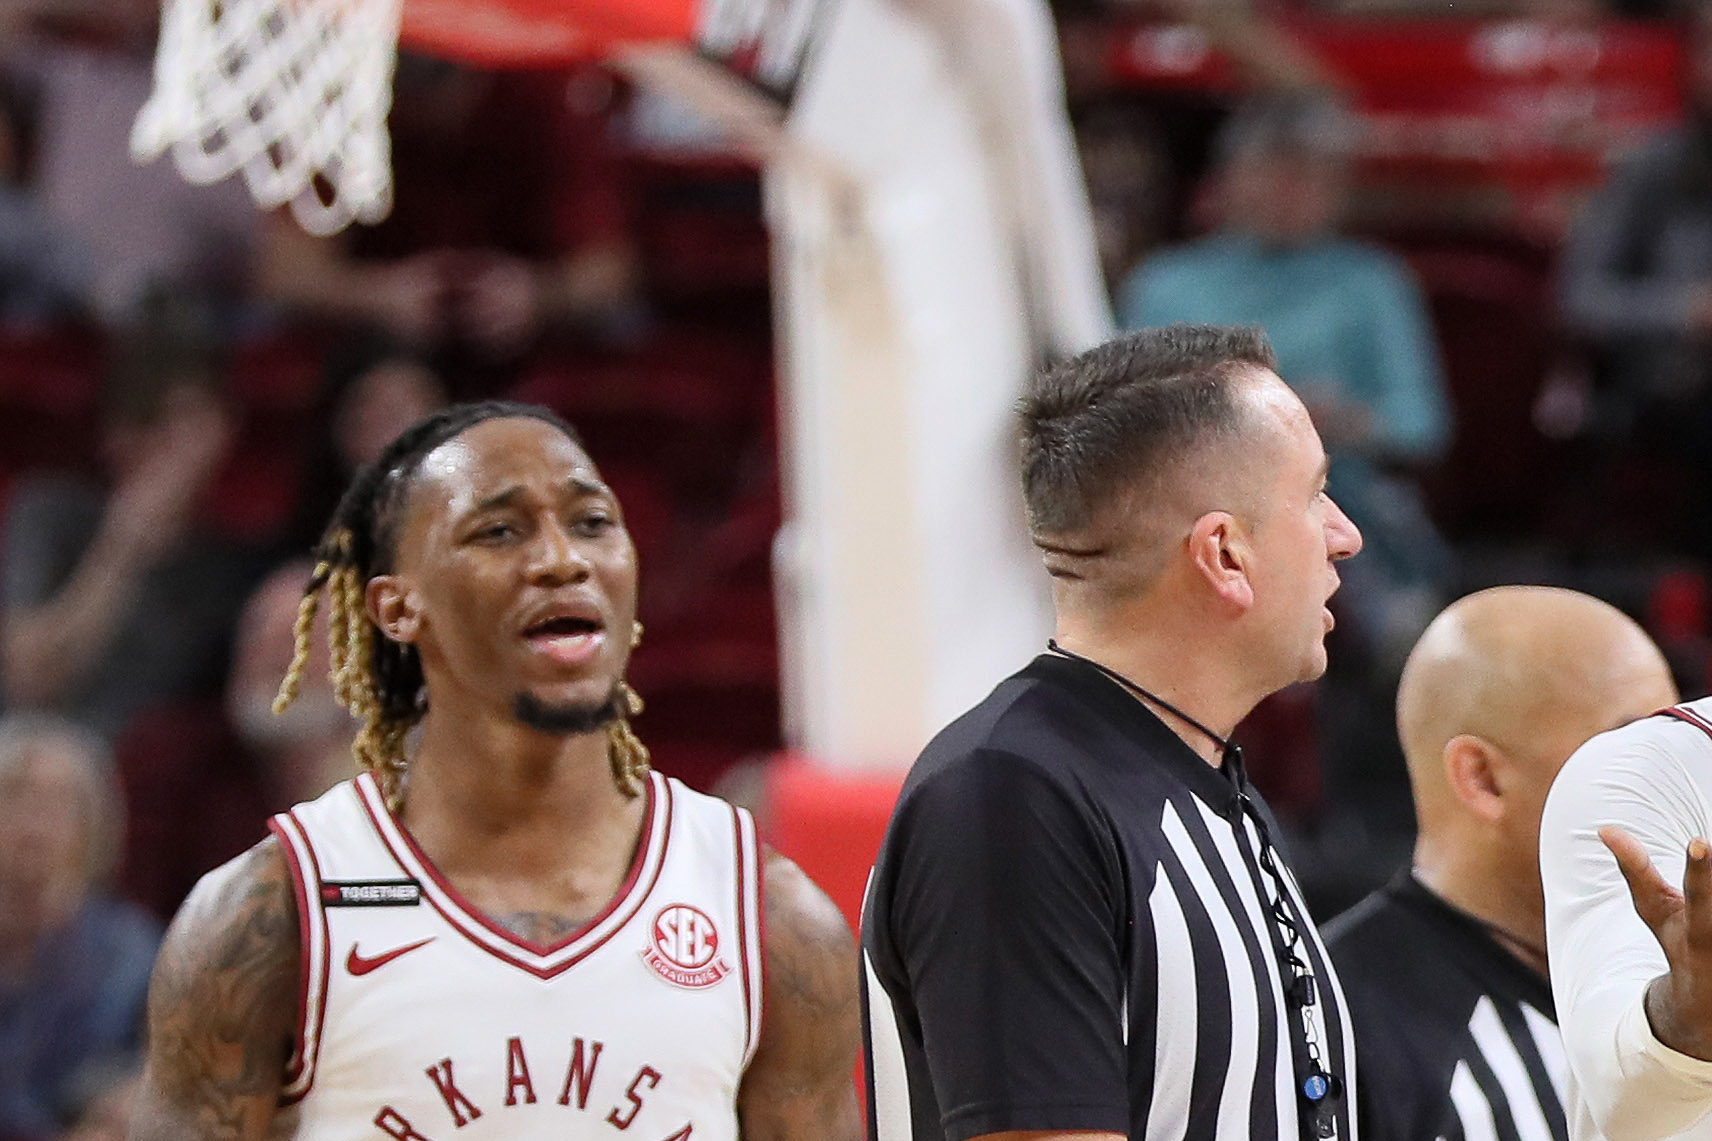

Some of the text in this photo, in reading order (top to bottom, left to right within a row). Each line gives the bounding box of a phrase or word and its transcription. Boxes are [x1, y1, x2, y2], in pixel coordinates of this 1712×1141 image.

[340, 885, 419, 902] TOGETHER
[654, 905, 719, 969] SEC
[651, 957, 720, 985] GRADUATE
